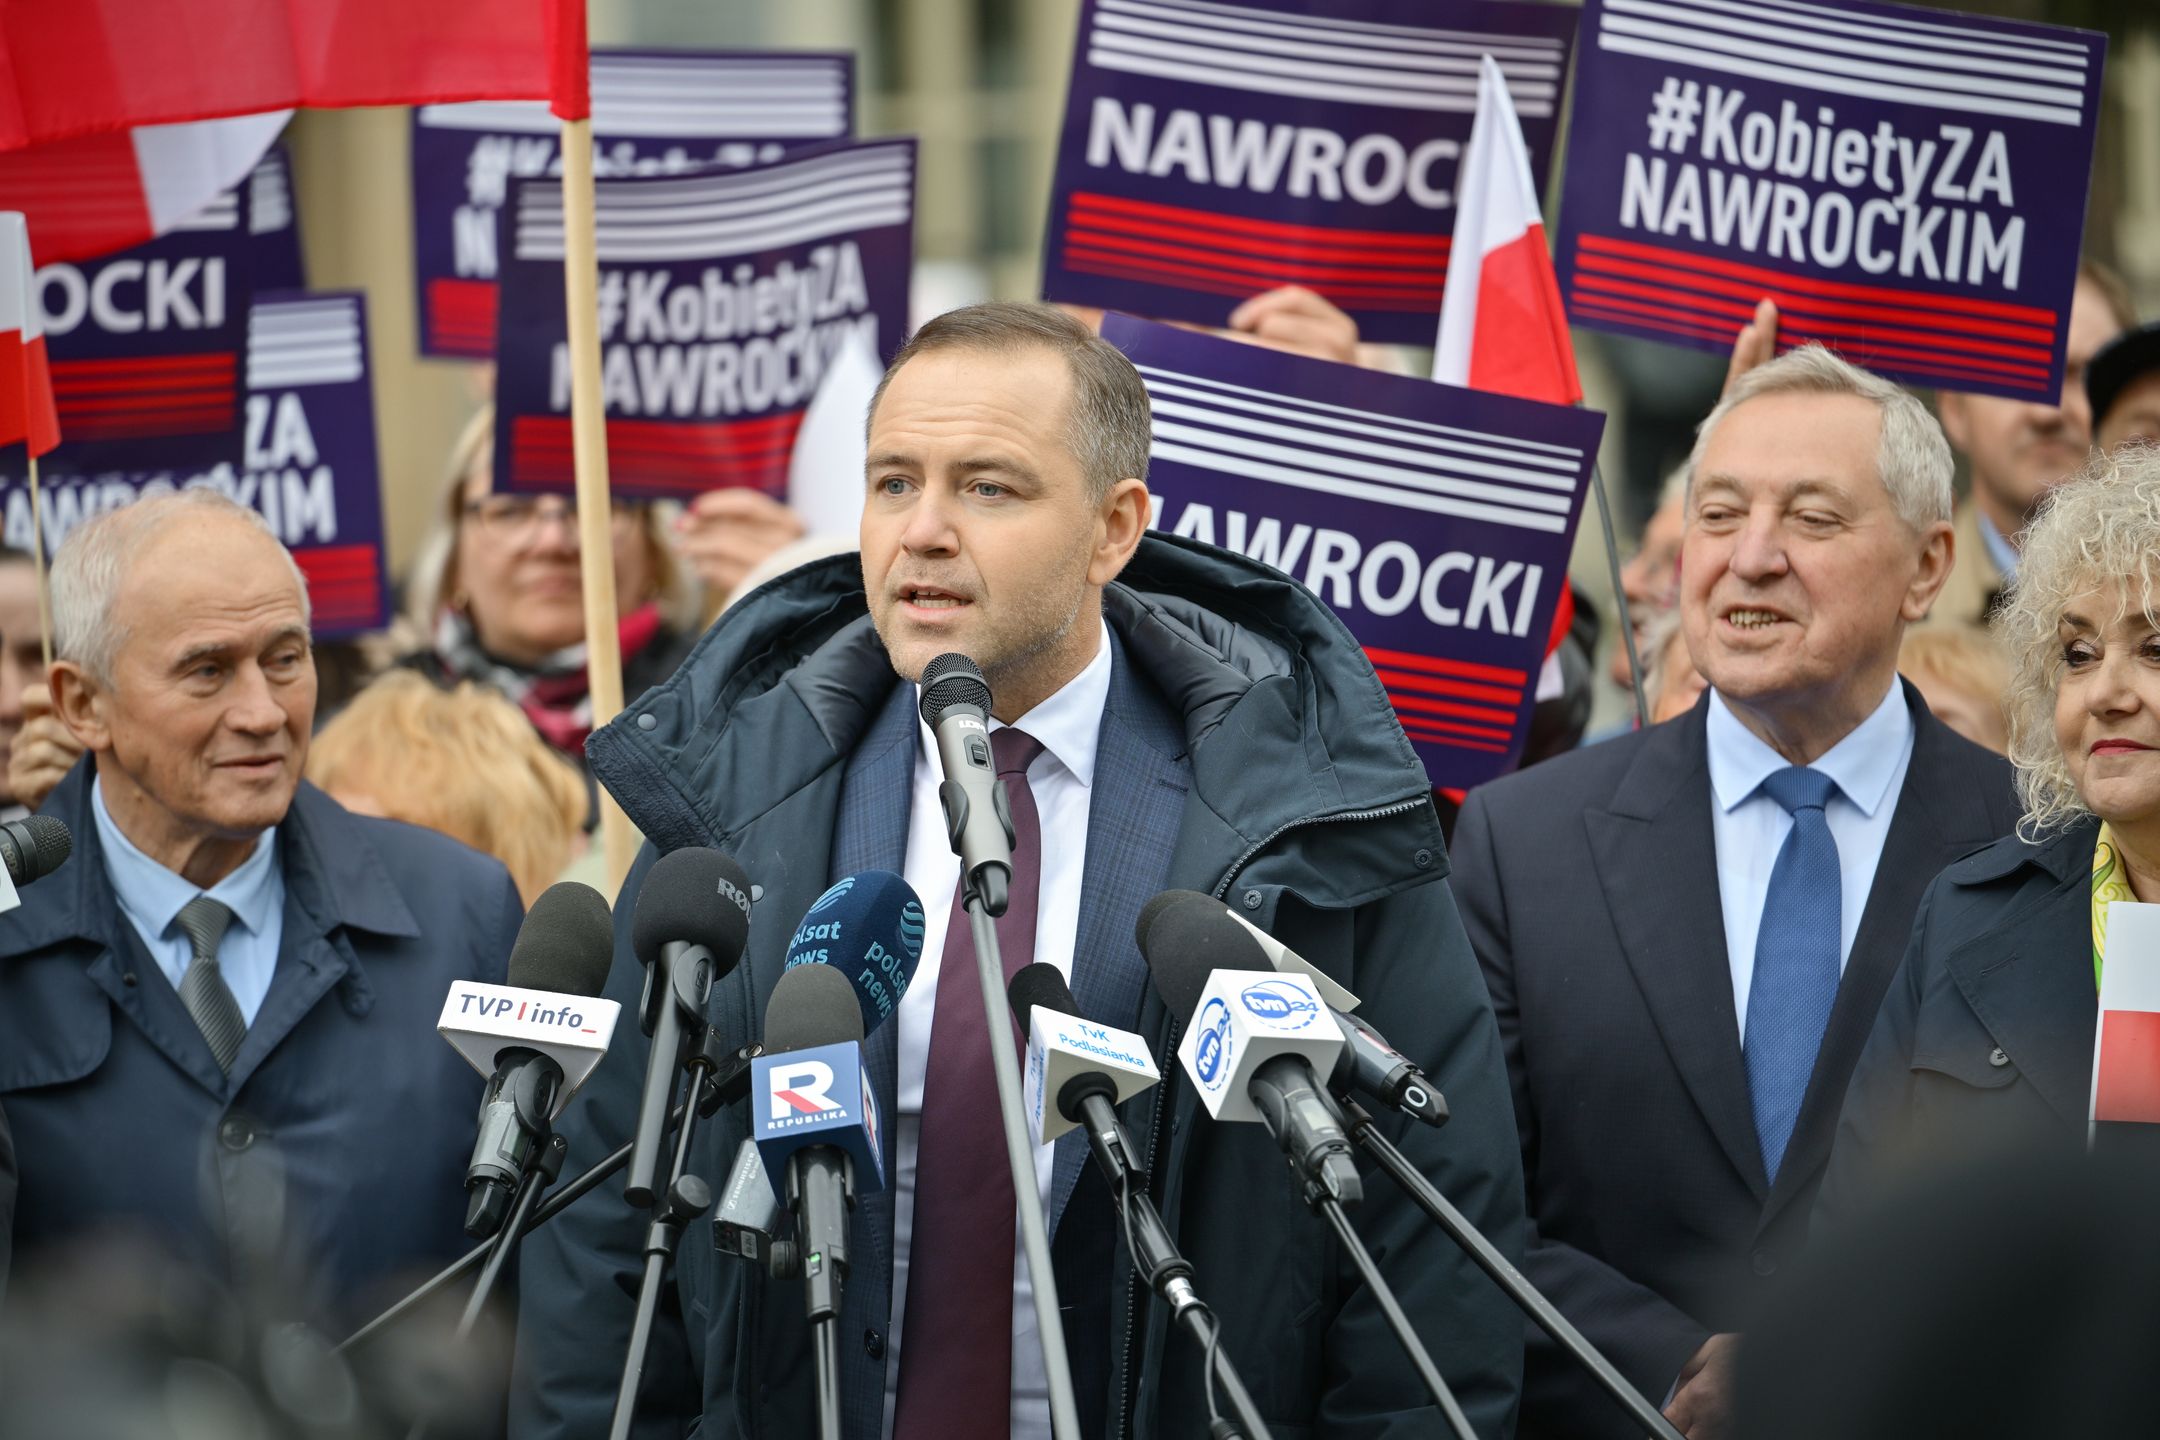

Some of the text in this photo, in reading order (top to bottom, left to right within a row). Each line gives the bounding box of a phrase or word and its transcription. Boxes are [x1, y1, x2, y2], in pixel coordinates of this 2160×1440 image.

[1086, 97, 1465, 210] NAWROC
[1647, 76, 2014, 210] #KobietyZA
[1619, 152, 2026, 291] NAWROCKIM
[34, 256, 226, 336] OCKI
[1147, 494, 1543, 638] AWROCKI
[461, 994, 513, 1018] TVP
[858, 966, 892, 1019] news
[1058, 1033, 1146, 1068] Podlasianka
[1078, 1024, 1111, 1042] TvK
[767, 1109, 848, 1130] REPUBLIKA
